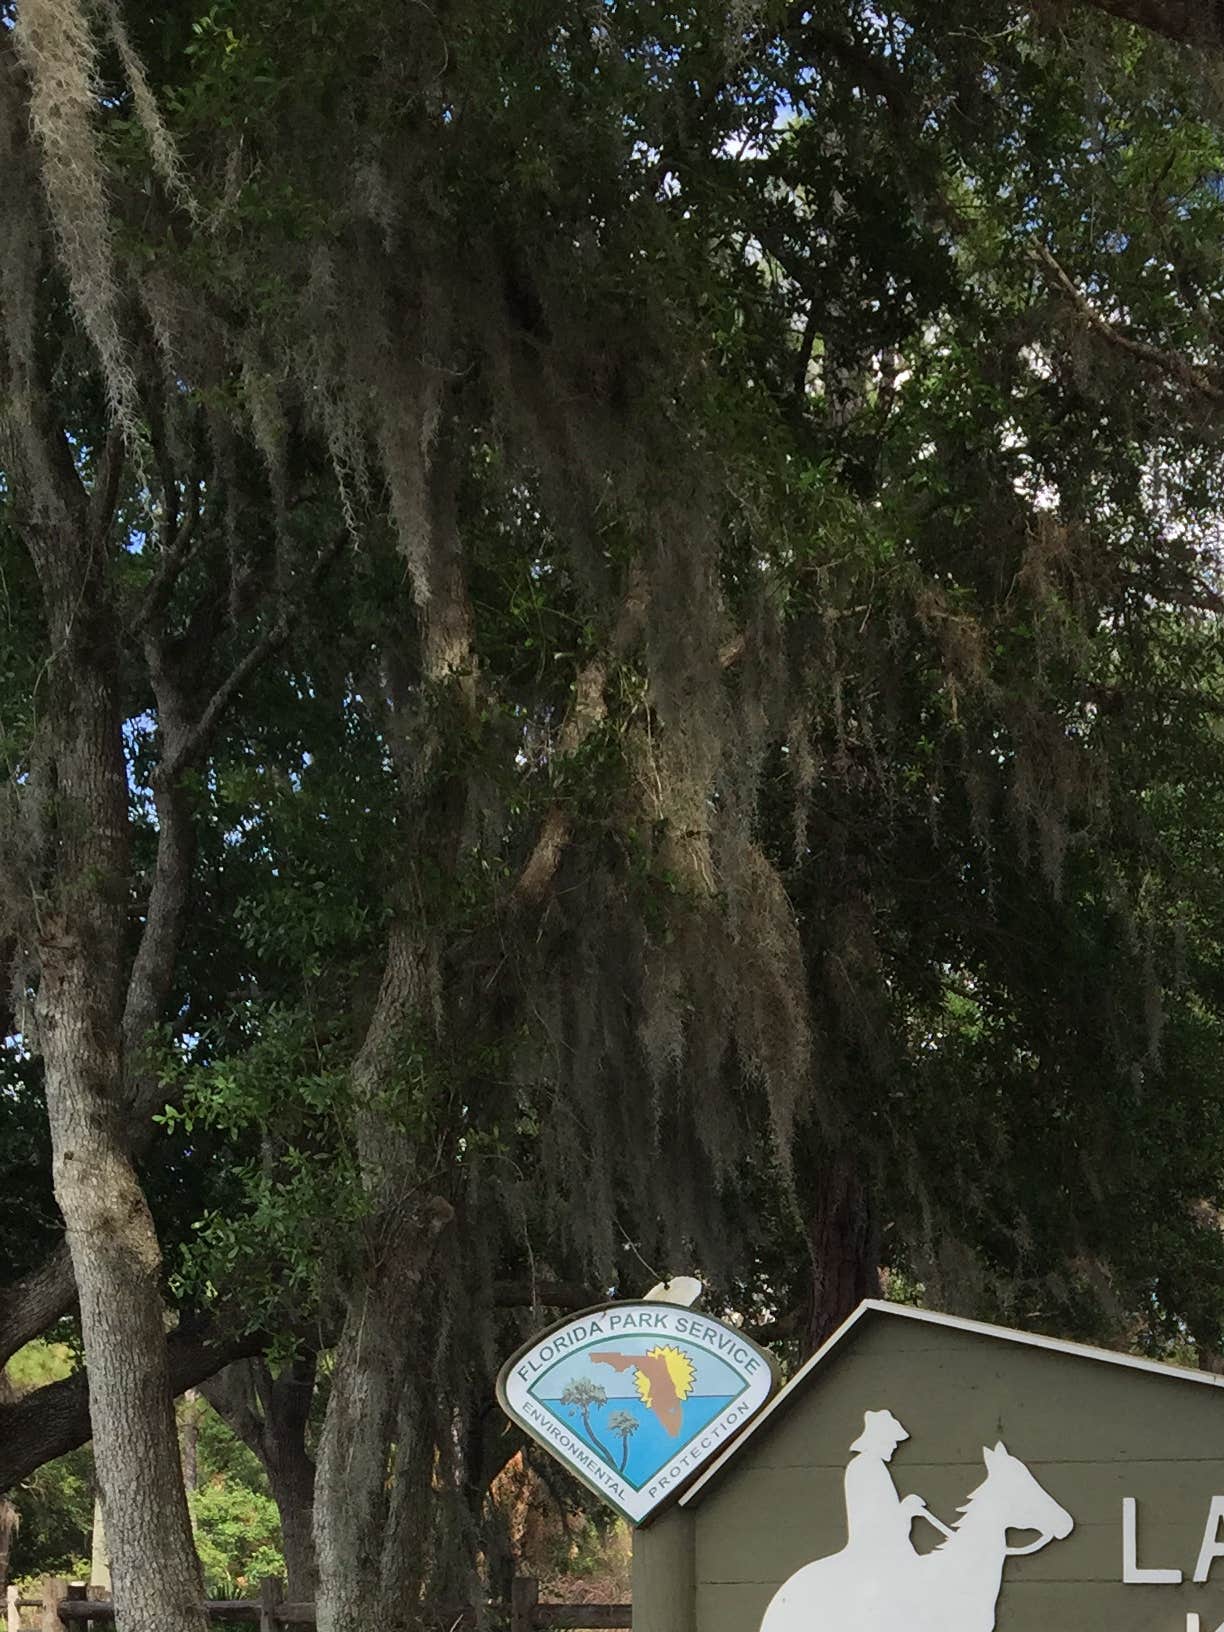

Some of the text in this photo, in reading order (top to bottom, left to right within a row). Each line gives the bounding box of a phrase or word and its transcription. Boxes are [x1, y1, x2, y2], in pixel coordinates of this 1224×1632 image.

[517, 1312, 761, 1383] FLORIDA PARK SERVICE
[521, 1400, 750, 1501] ENVIRONMENTAL PROTECTION
